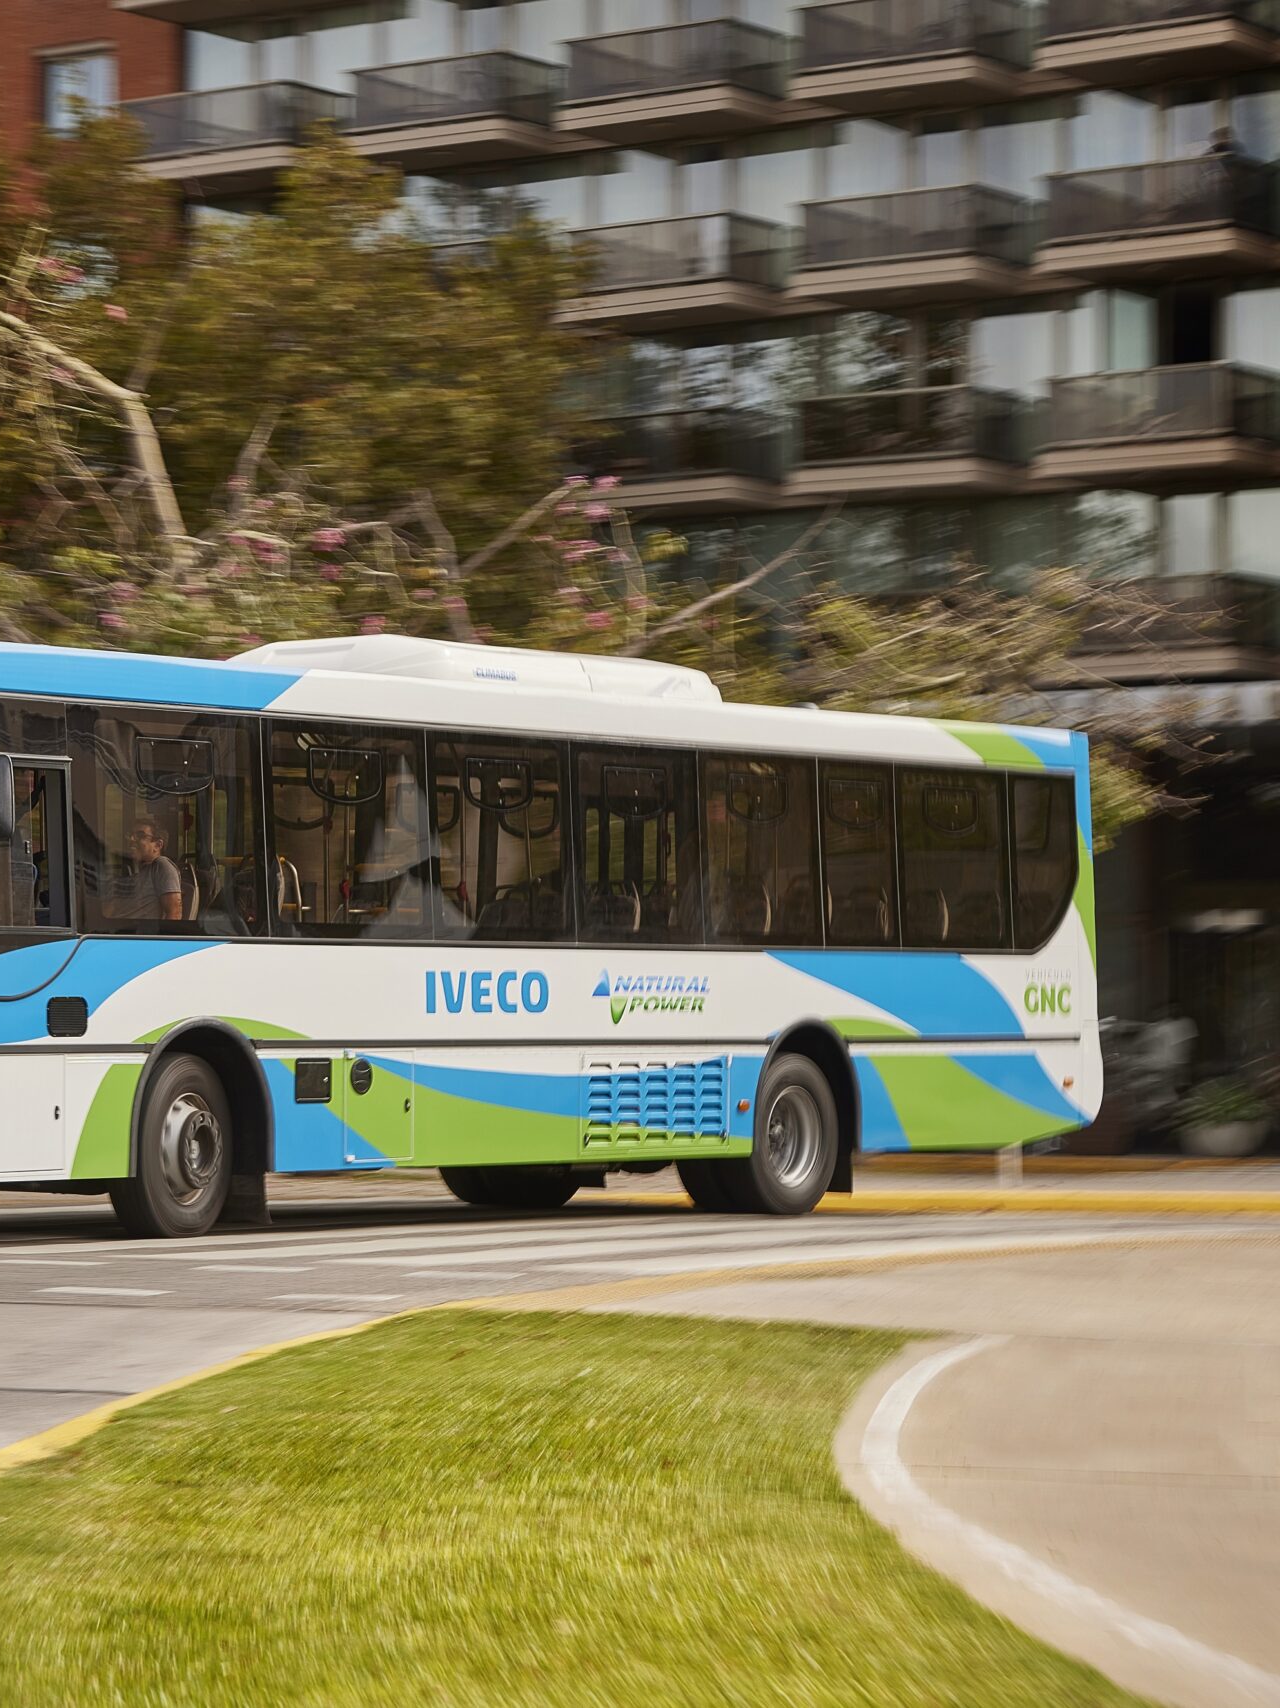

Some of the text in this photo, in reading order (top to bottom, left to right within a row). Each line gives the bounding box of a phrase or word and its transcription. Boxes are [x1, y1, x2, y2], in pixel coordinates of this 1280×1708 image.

[425, 970, 549, 1013] IVECO
[614, 975, 710, 993] NATURAL
[629, 996, 705, 1013] POWER
[1024, 984, 1072, 1014] GNC
